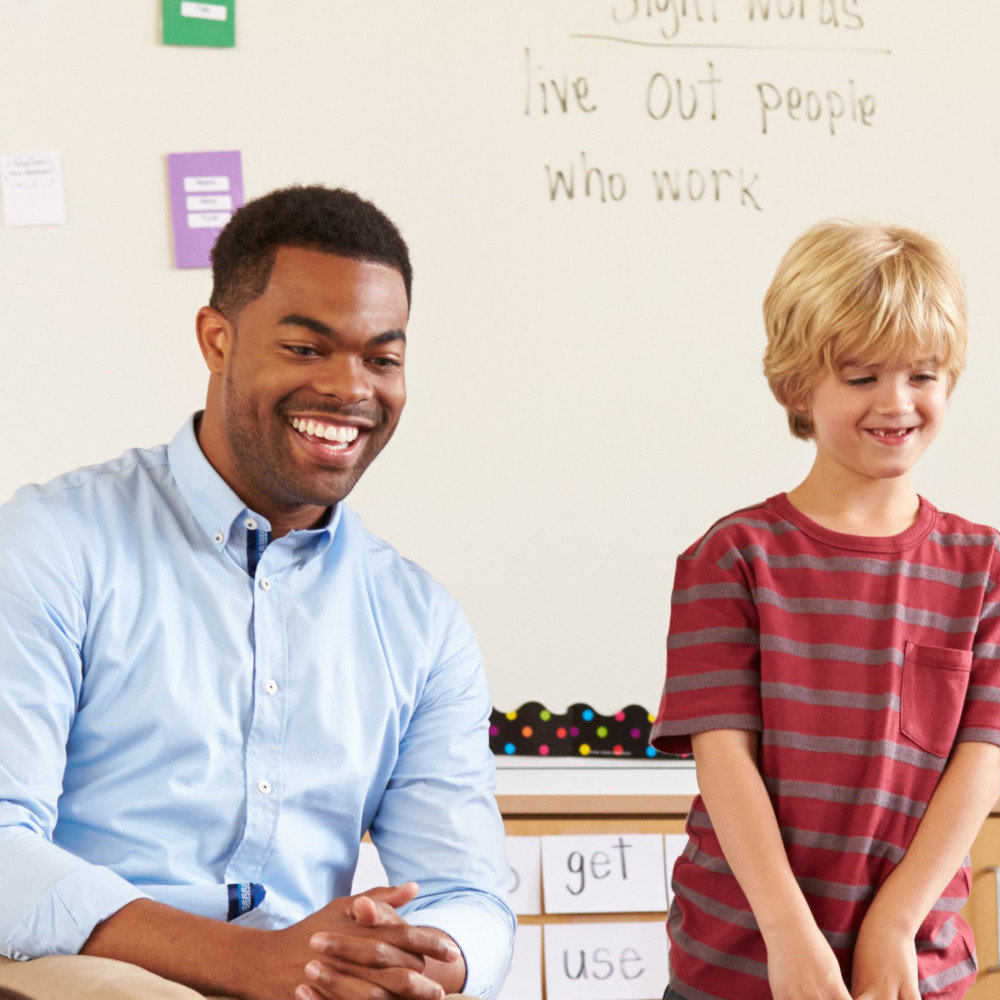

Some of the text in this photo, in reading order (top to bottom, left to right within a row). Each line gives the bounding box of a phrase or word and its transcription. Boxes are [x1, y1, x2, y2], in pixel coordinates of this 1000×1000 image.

[524, 47, 598, 116] live
[756, 78, 876, 135] people
[544, 151, 763, 212] who work
[565, 837, 633, 895] get
[562, 947, 645, 981] use
